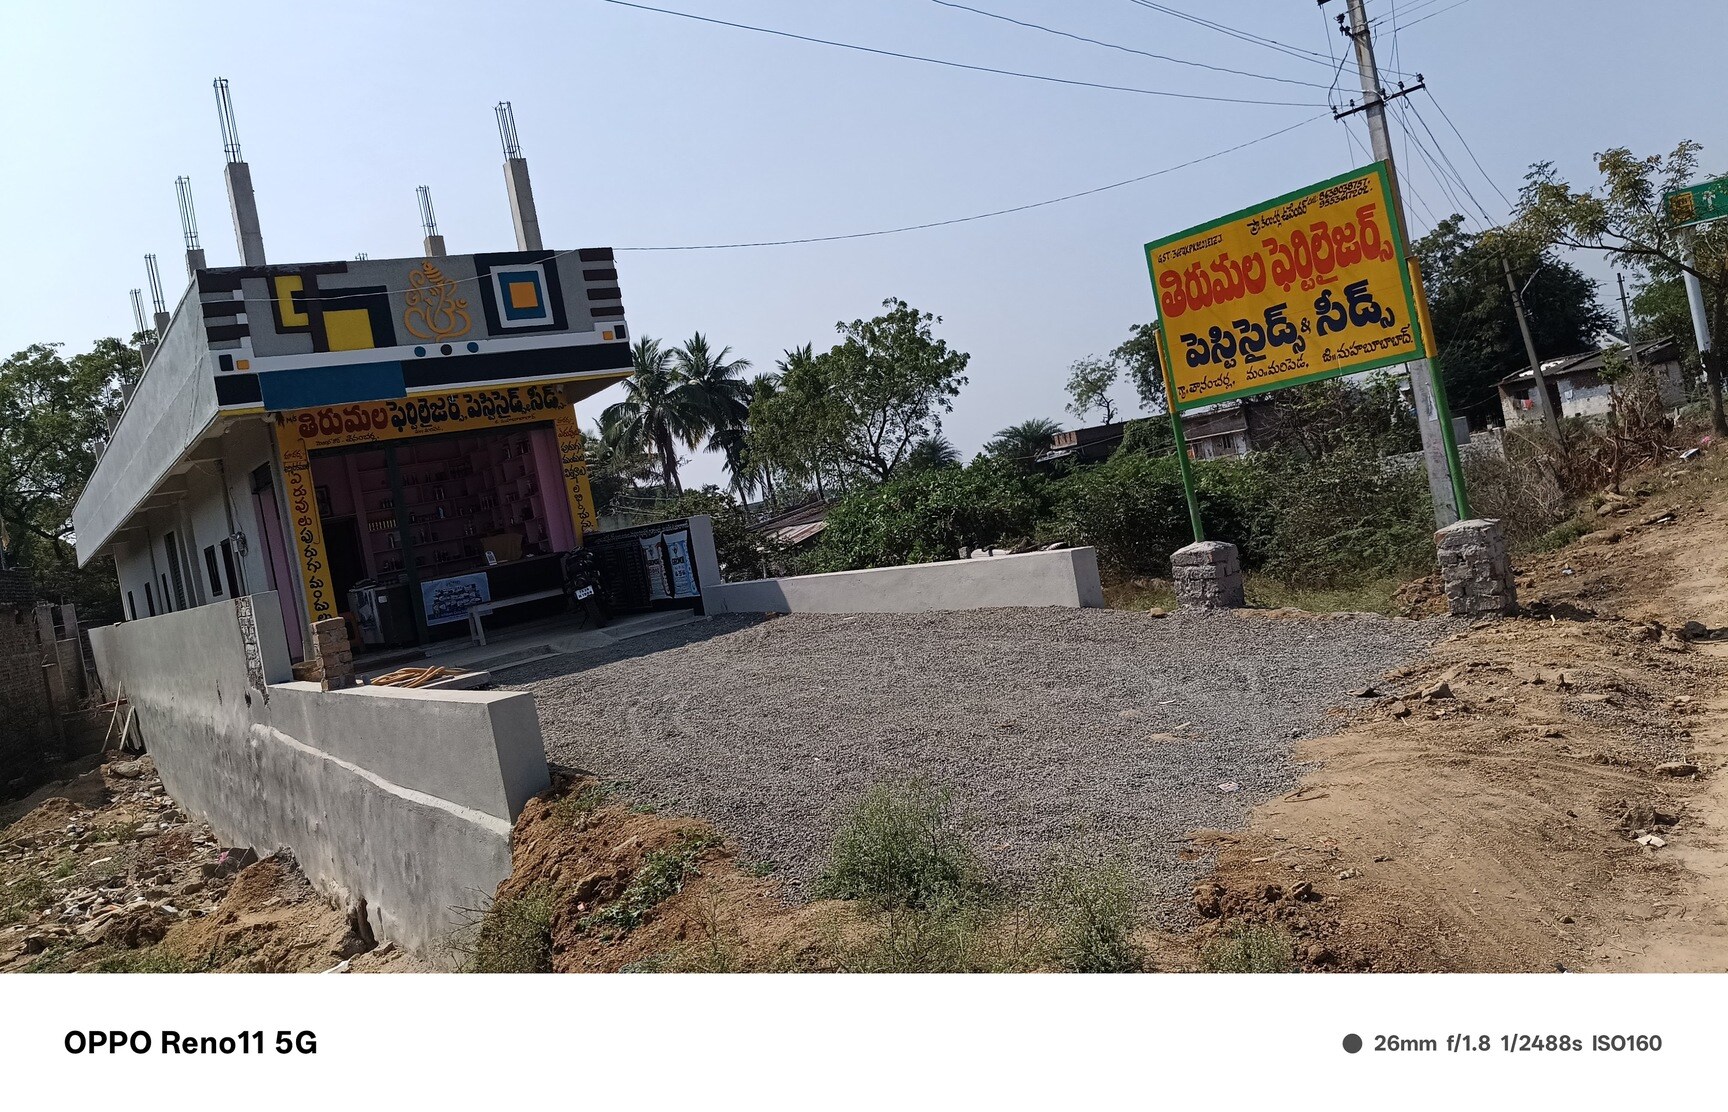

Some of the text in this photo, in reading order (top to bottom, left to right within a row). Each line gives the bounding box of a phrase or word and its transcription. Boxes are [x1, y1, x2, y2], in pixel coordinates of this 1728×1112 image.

[1159, 203, 1394, 318] తిరుమల ఫెర్టిలైజర్స్
[1180, 279, 1395, 369] పెస్టిసైడ్స్ & సీడ్స్
[298, 405, 388, 438] తిరుమల
